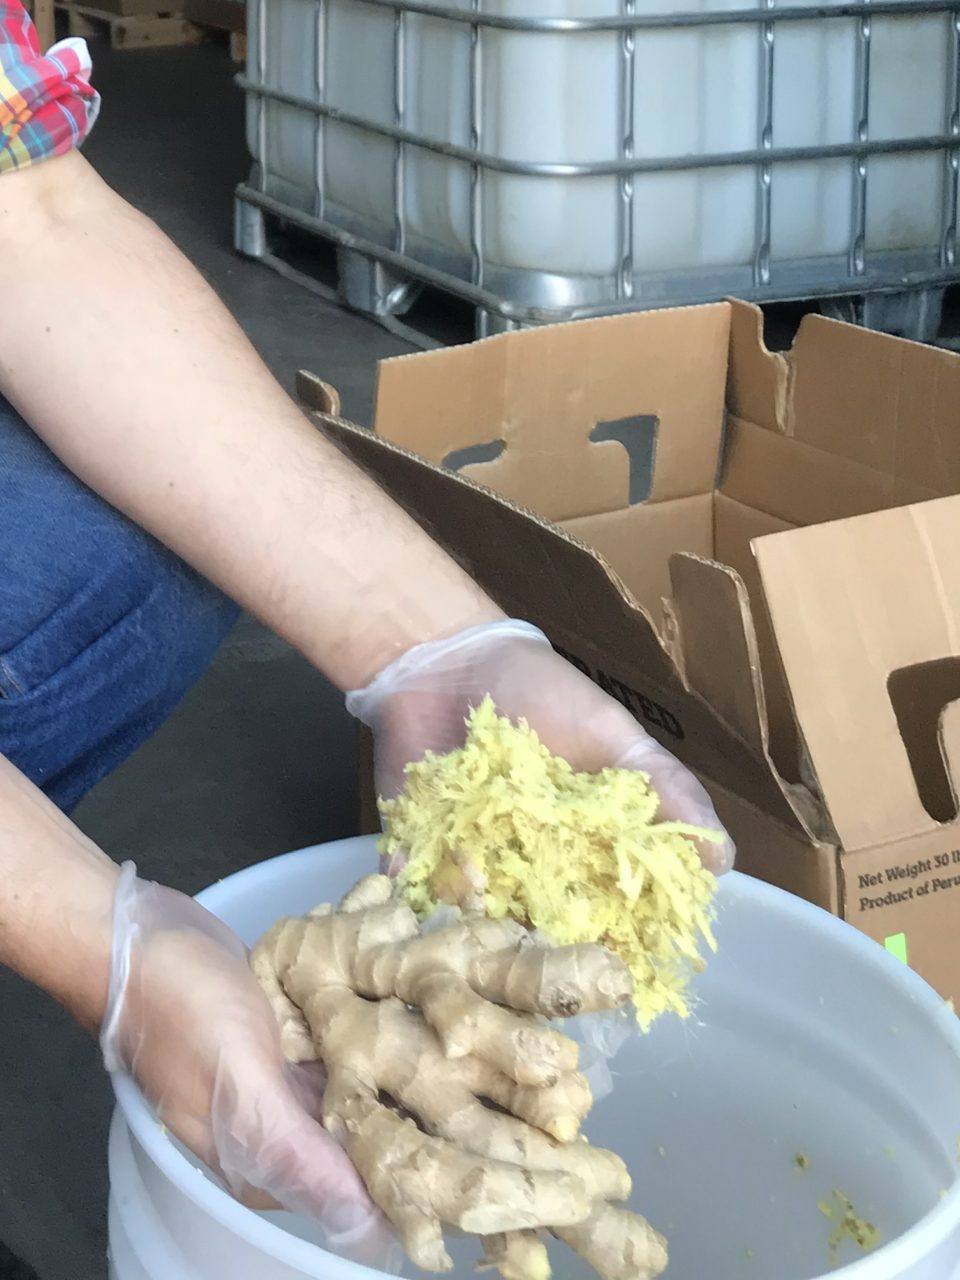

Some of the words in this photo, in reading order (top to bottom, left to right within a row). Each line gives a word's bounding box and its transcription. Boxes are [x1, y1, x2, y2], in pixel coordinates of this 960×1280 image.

[858, 872, 883, 887] Net
[885, 859, 931, 881] Weight
[859, 887, 914, 911] Product
[916, 880, 931, 896] of
[932, 875, 960, 892] Peru
